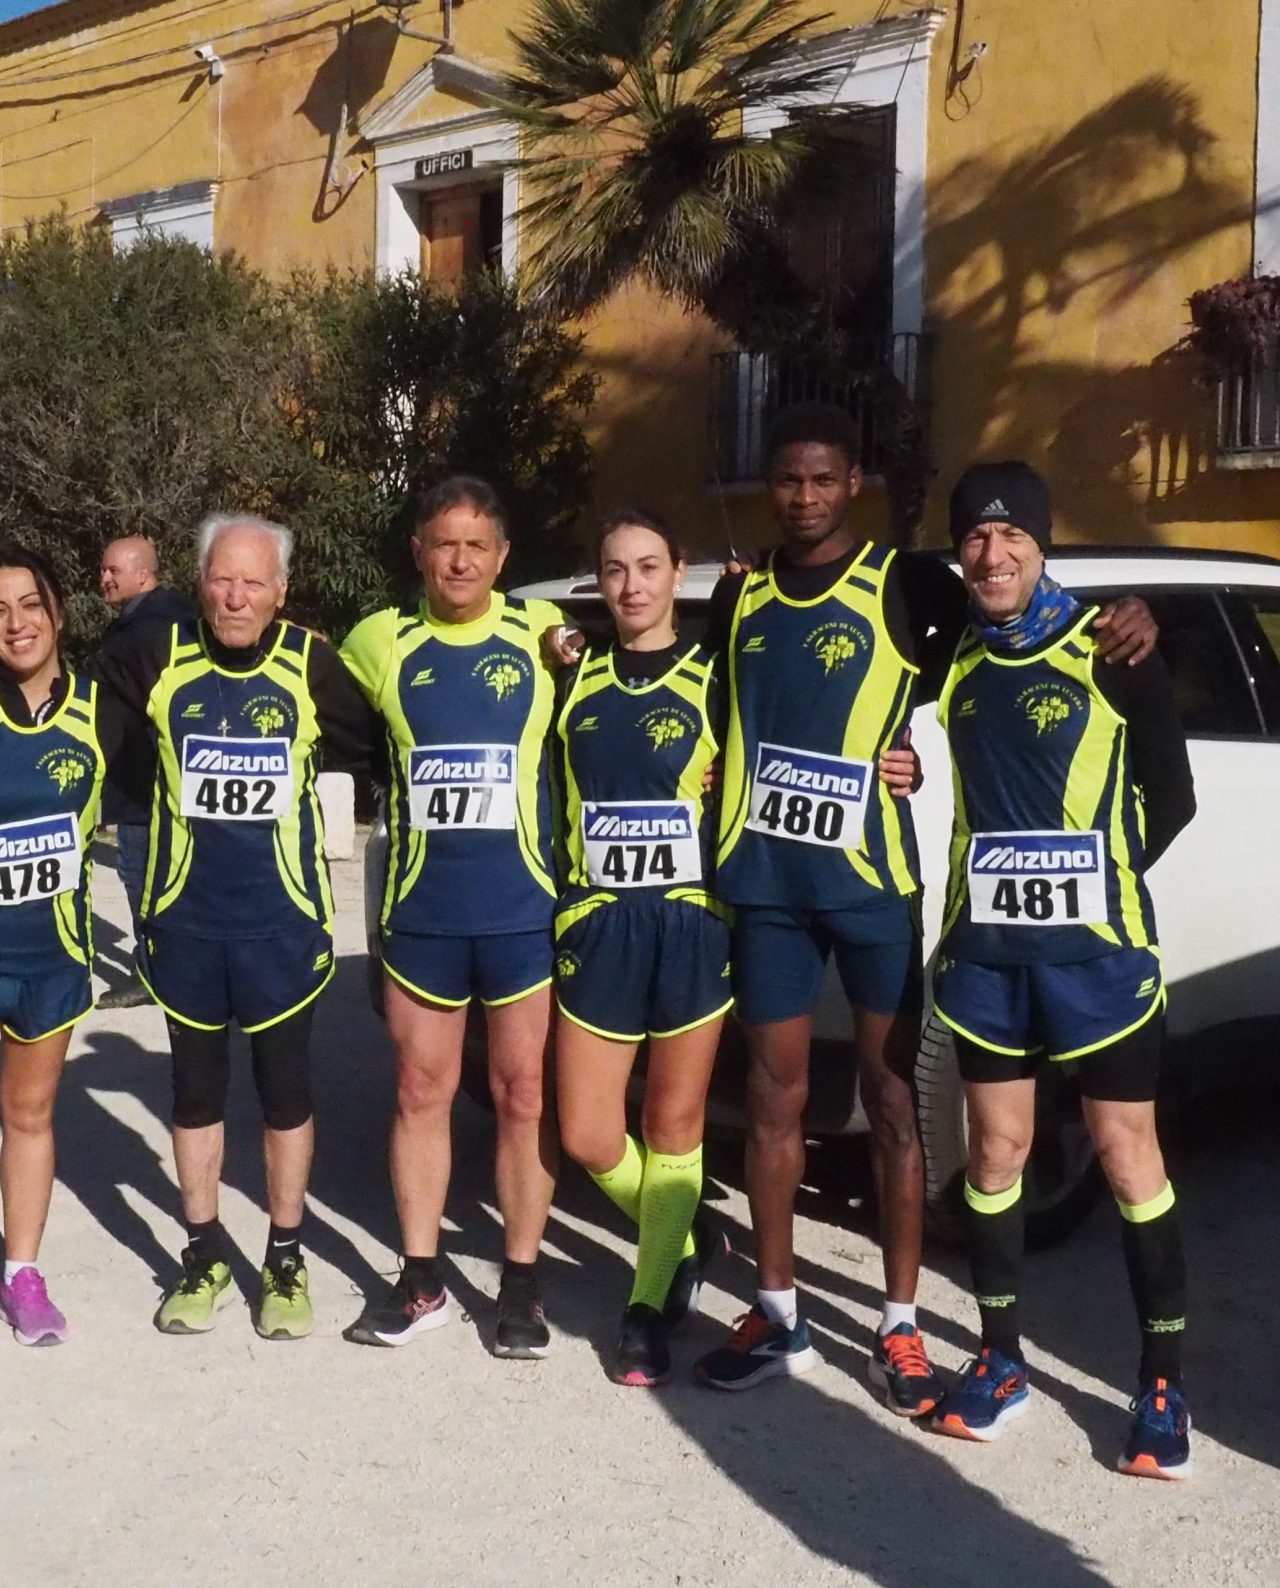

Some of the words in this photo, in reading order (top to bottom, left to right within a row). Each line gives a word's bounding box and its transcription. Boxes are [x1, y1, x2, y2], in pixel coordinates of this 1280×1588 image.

[422, 153, 465, 175] UFFICI
[196, 778, 276, 815] 482
[427, 787, 493, 824] 477
[759, 790, 844, 841] 480
[602, 844, 677, 882] 474
[992, 878, 1079, 920] 481
